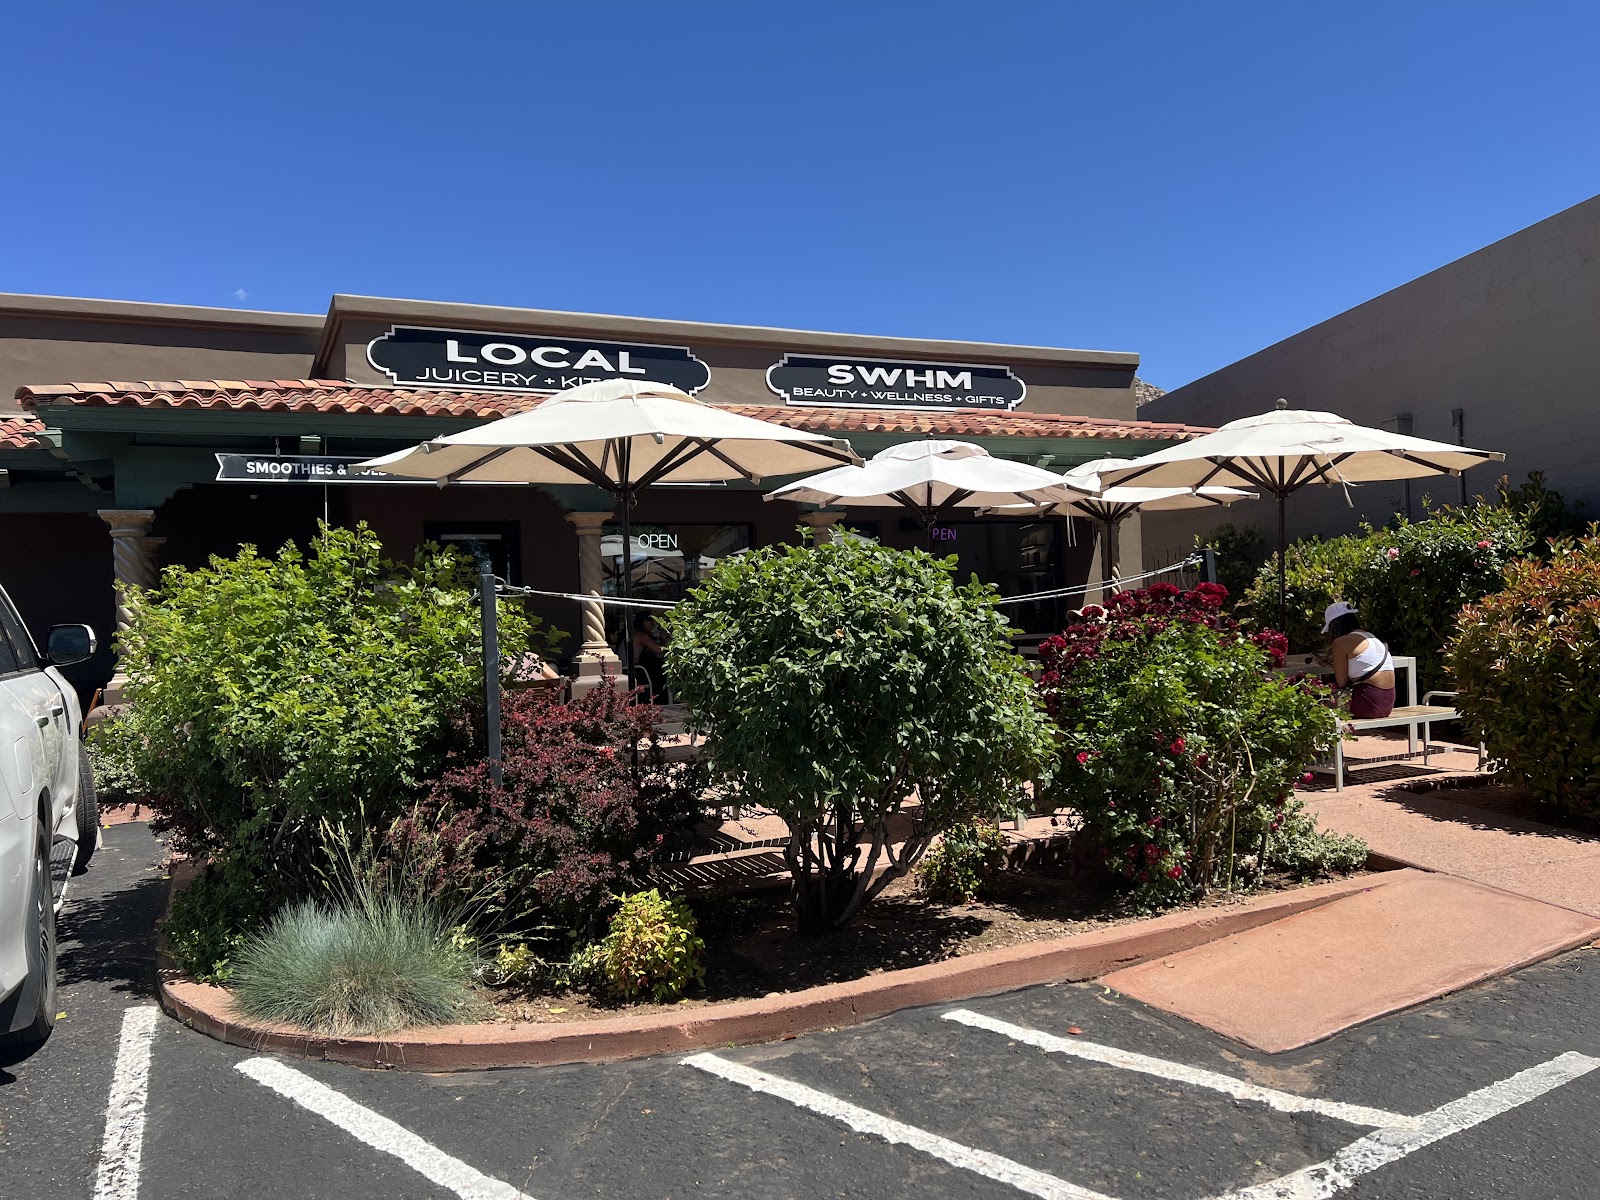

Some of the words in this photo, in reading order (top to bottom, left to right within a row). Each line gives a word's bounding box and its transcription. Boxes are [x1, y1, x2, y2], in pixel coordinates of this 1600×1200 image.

[446, 339, 645, 374] LOCAL
[416, 367, 537, 386] JUICERY
[827, 364, 972, 390] SWHM
[792, 387, 858, 399] BEAUTY
[869, 390, 953, 403] WELLNESS
[965, 395, 1005, 405] GIFTS
[246, 461, 334, 475] SMOOTHIES
[336, 463, 347, 475] &
[638, 533, 678, 549] OPEN
[932, 527, 957, 541] PEN
